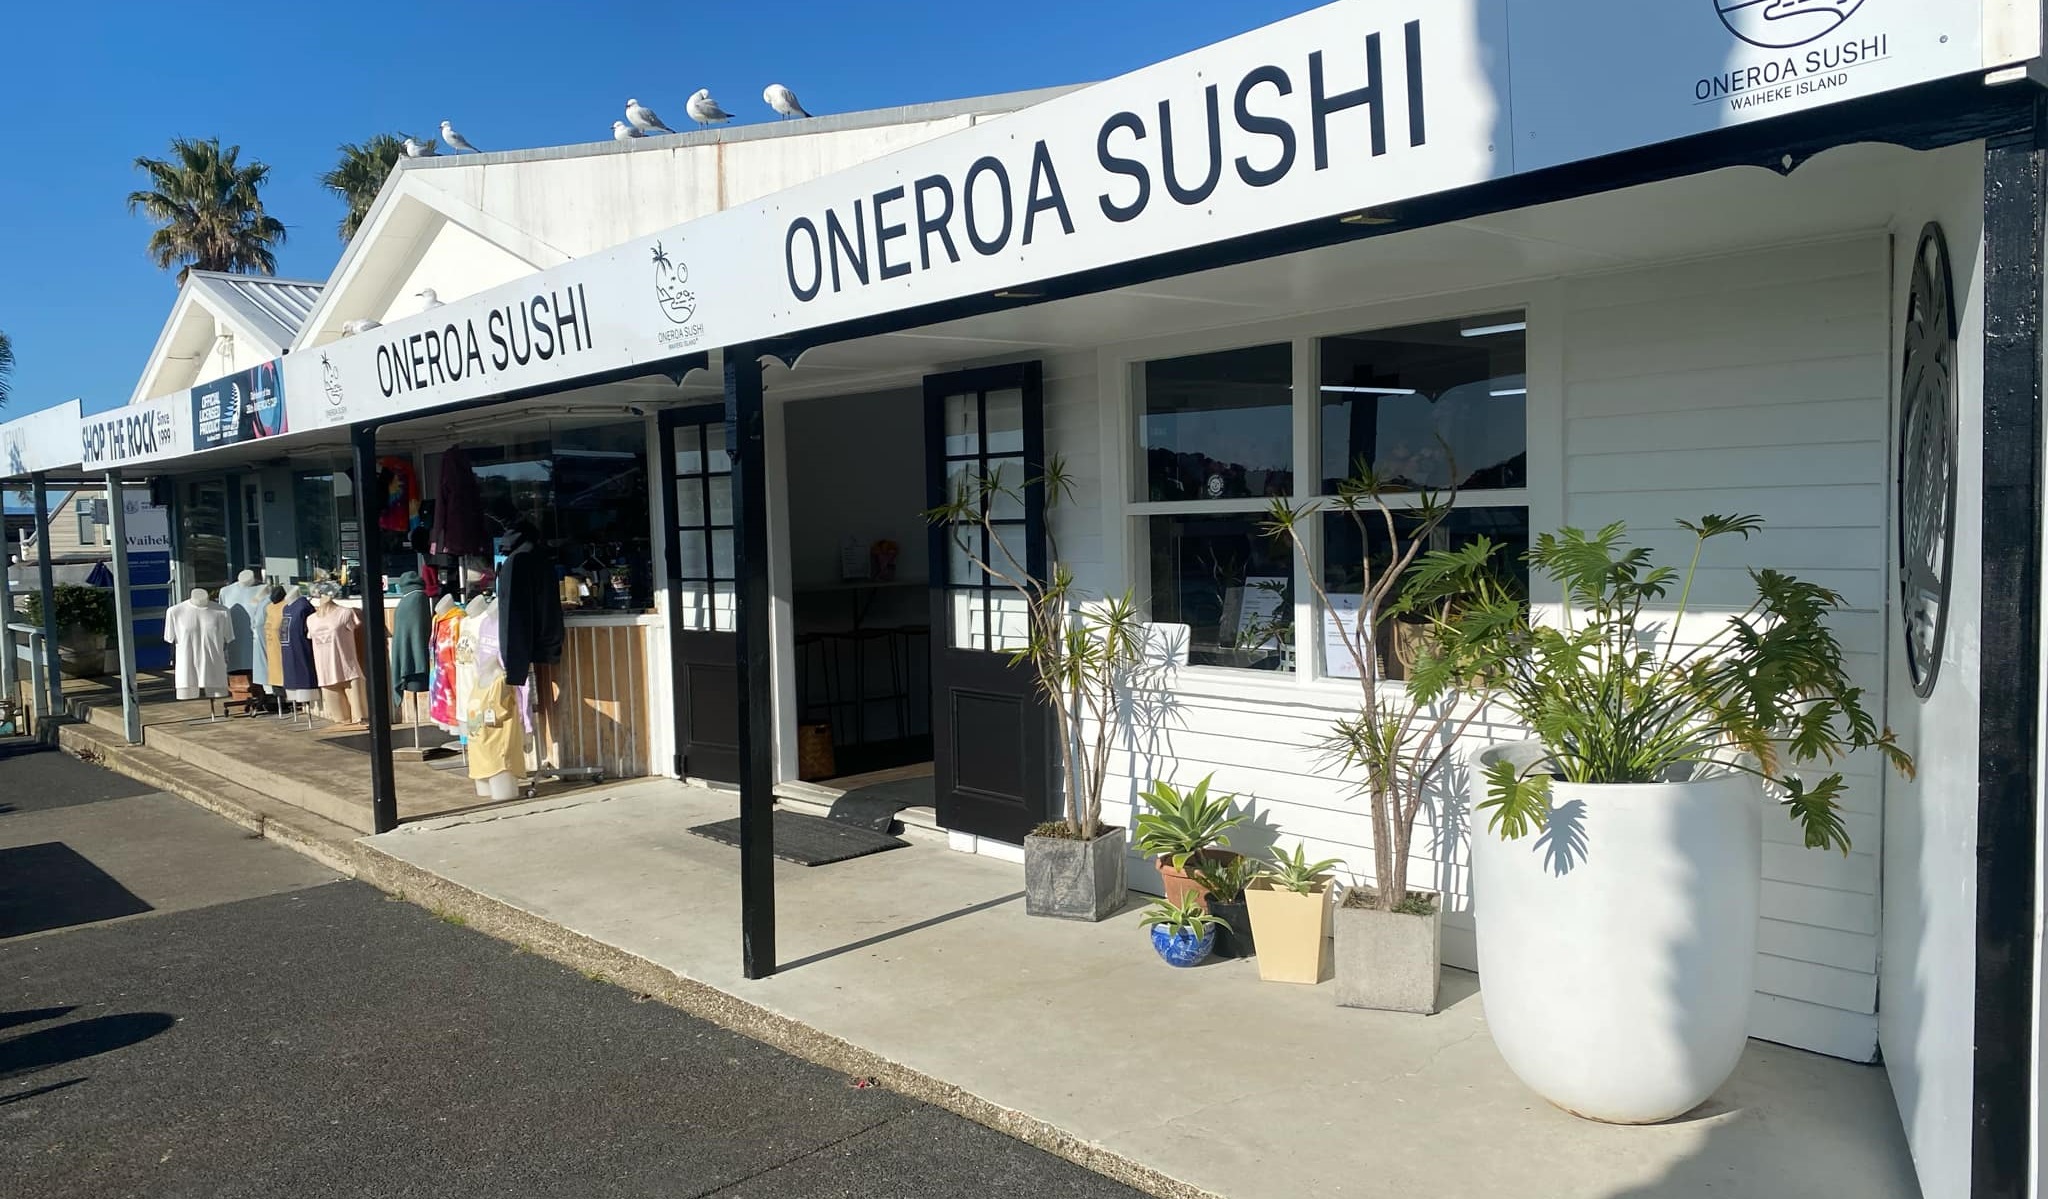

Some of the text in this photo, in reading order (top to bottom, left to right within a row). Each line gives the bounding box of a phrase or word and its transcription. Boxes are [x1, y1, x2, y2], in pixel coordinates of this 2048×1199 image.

[1695, 33, 1887, 100] ONEROA SUSHI
[1730, 73, 1848, 111] WAIHEKE ISLAND
[785, 19, 1426, 303] ONEROA SUSHI
[376, 282, 593, 398] ONEROA SUSHI
[658, 323, 704, 342] ONEROA SUSHI
[82, 409, 158, 463] SHOP THE ROCK
[156, 410, 170, 426] Since
[157, 427, 171, 446] 1999
